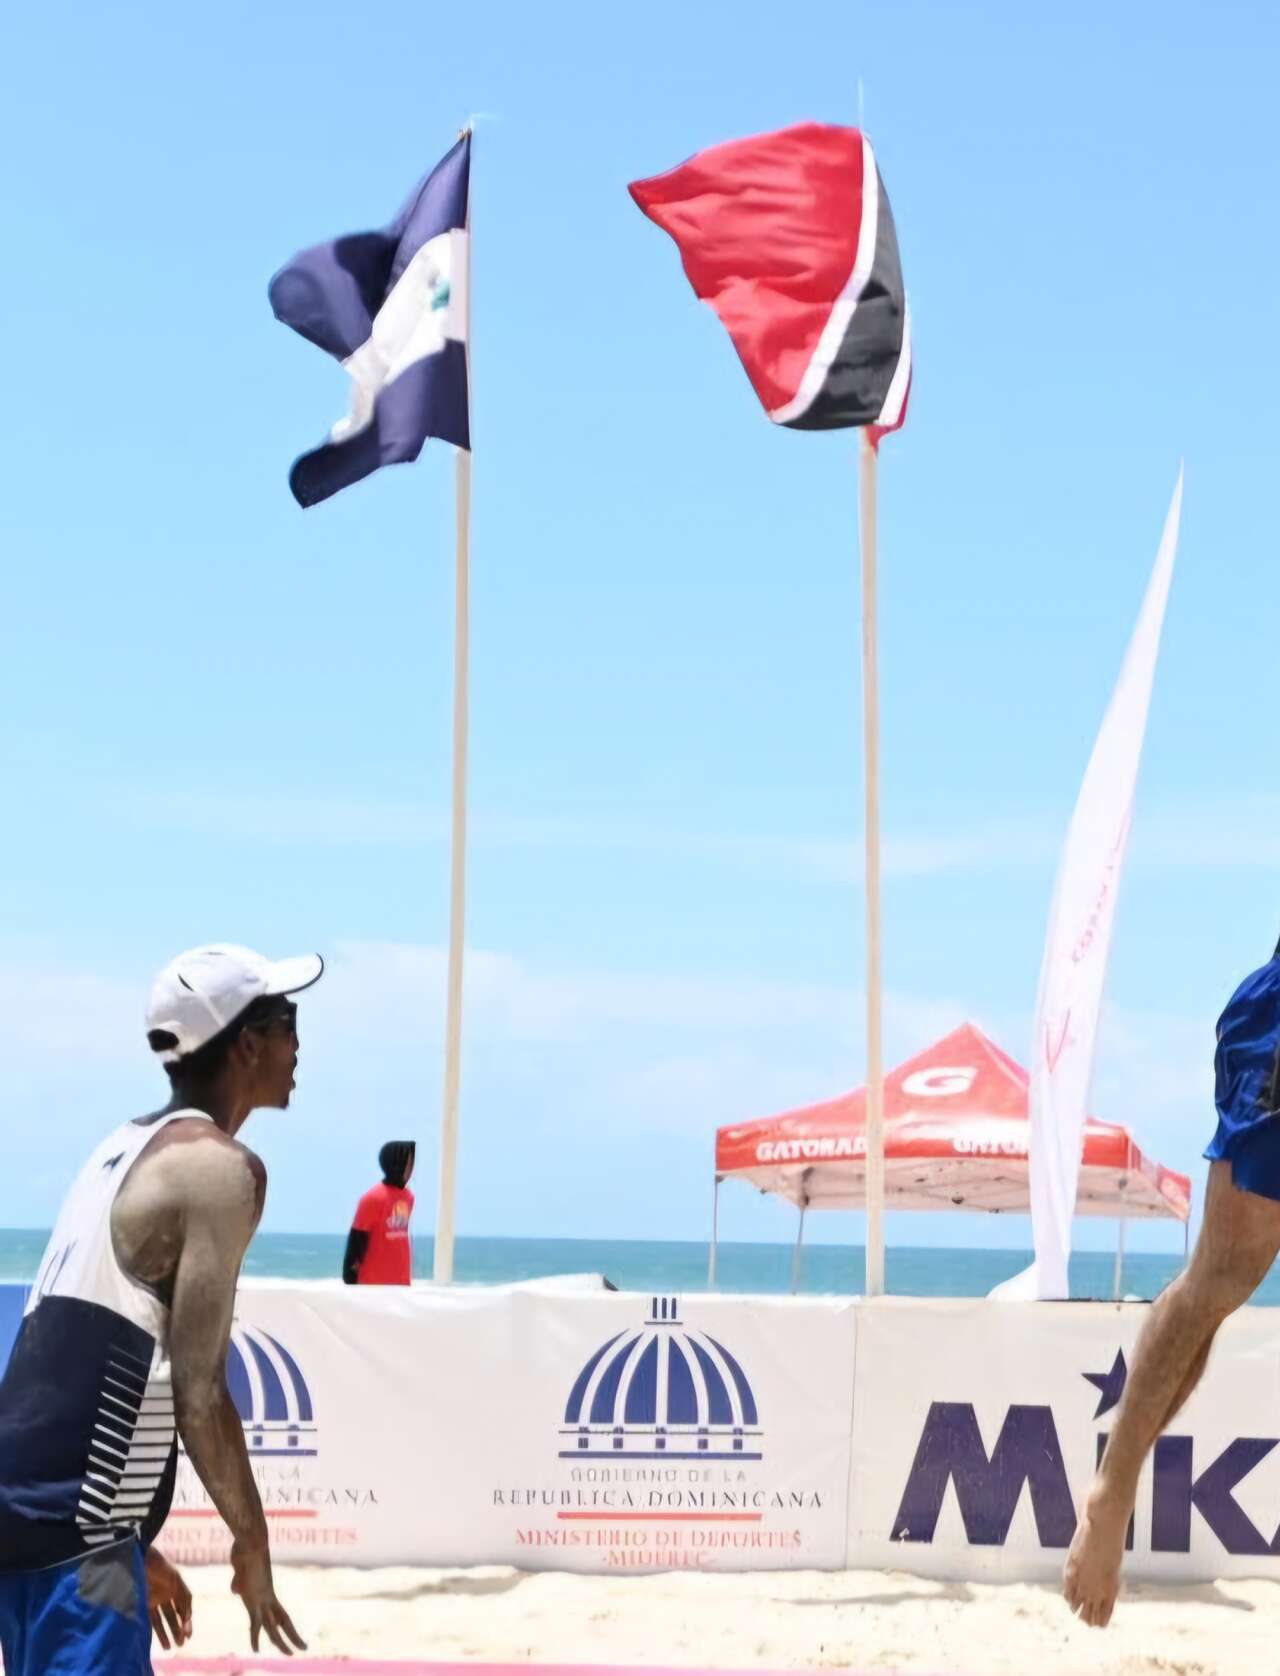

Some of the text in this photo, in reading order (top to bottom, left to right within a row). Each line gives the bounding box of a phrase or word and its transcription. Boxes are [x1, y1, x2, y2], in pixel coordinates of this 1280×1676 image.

[901, 1067, 978, 1096] G
[756, 1136, 866, 1160] GATORAD
[724, 1469, 748, 1482] LA
[266, 1488, 378, 1506] INICANA
[649, 1490, 822, 1508] DOMINICANA
[515, 1528, 648, 1546] MINISTERIO
[655, 1530, 682, 1547] DE
